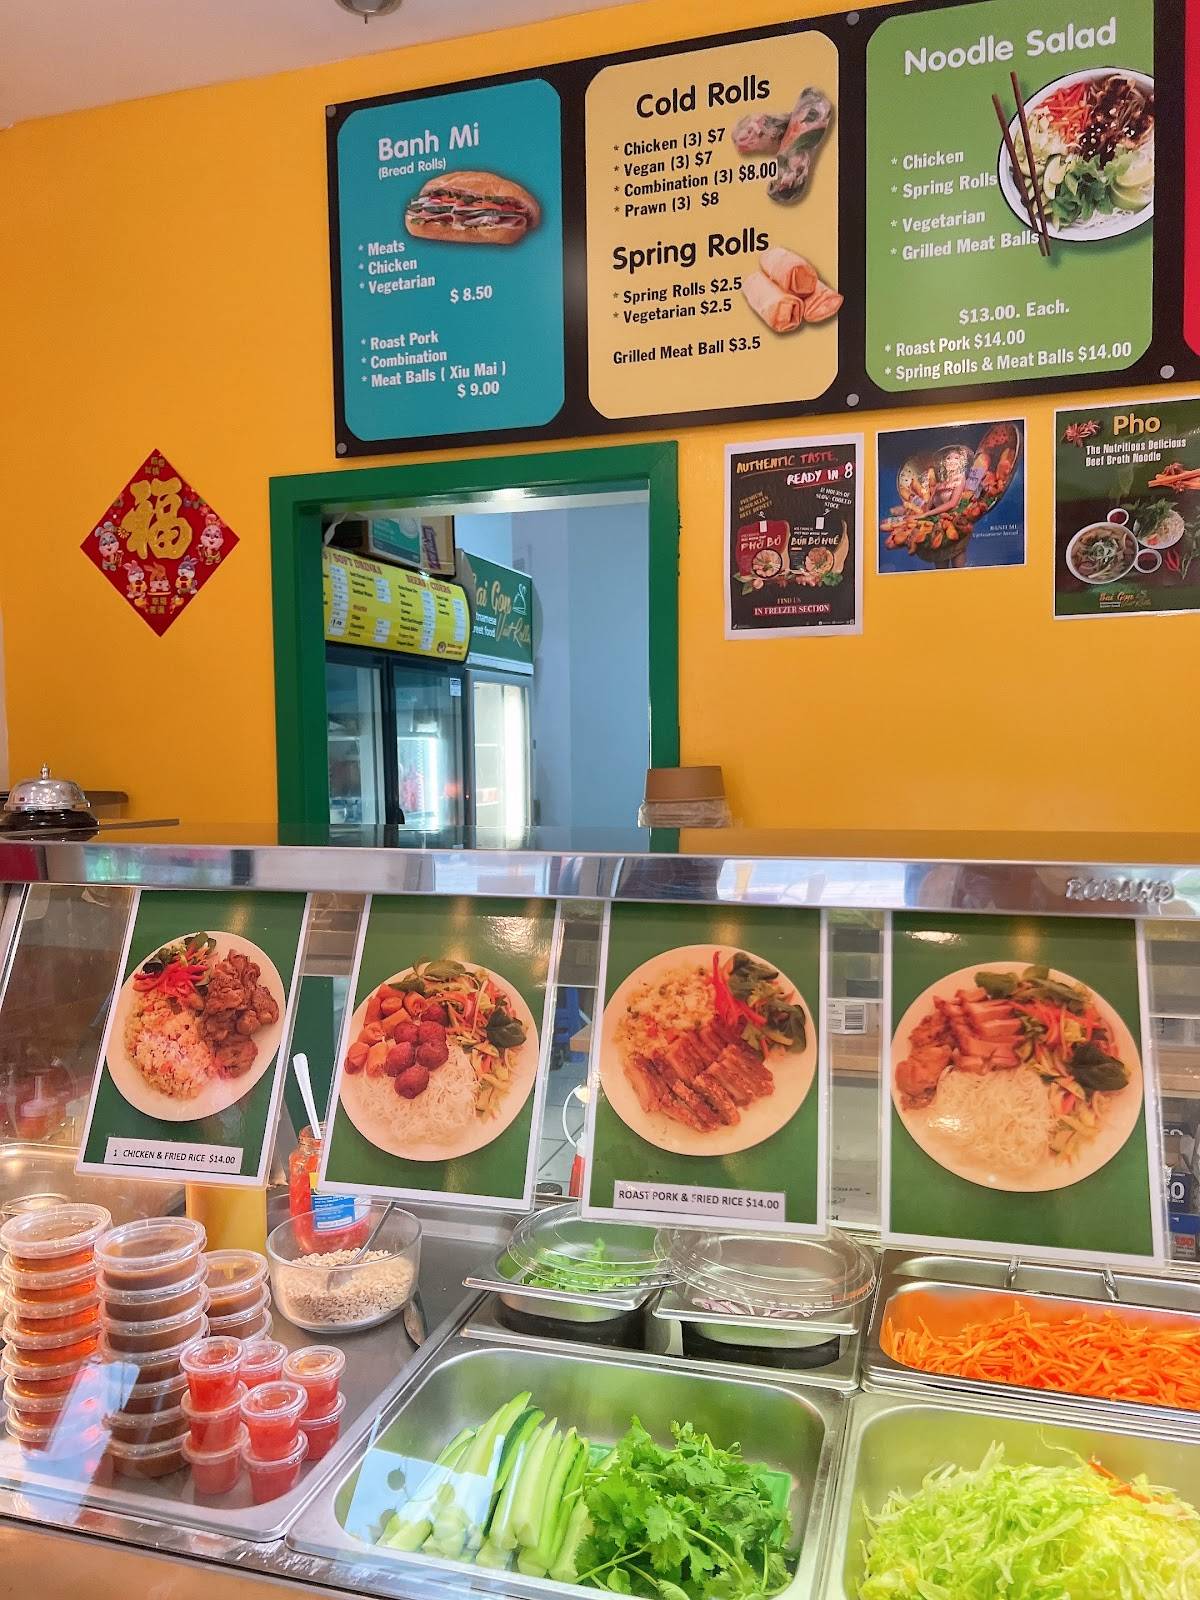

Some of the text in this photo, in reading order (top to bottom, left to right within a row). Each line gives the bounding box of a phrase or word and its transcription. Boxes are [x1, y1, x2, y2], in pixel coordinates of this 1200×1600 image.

[904, 16, 1117, 76] Noodle Salad
[636, 75, 770, 118] Cold Rolls
[378, 122, 479, 161] Banh Mi
[624, 128, 726, 156] Chicken (3) $7
[378, 158, 446, 180] (Bread Rolls)
[624, 151, 713, 177] Vegan (3) $7
[902, 151, 964, 170] Chicken
[624, 161, 777, 197] Combination (3) $8.00
[903, 172, 998, 200] Spring Rolls
[625, 192, 720, 217] Prawn (3) $8
[902, 210, 986, 233] Vegetarian
[368, 240, 405, 256] Meats
[612, 227, 769, 274] Spring Rolls
[902, 230, 1040, 261] Grilled Meat Balls
[368, 259, 418, 275] Chicken
[368, 275, 436, 294] Vegetarian
[623, 276, 742, 305] Spring Rolls $2.5
[624, 298, 732, 324] Vegetarian $2.5
[959, 299, 1070, 325] $13.00. Each.
[370, 330, 439, 350] Roast Pork
[613, 336, 761, 365] Grilled Meat Ball $3.5
[896, 329, 1026, 357] Roast Pork $14.00
[370, 350, 447, 369] Combination
[895, 341, 1132, 382] Spring Rolls & Meat Balls $14.00
[371, 372, 401, 387] Meat
[405, 369, 436, 384] Balls
[1112, 413, 1161, 436] Pho
[1086, 439, 1186, 455] The Nutritious Delicious
[736, 455, 795, 474] AUTHENTIC
[1085, 451, 1161, 467] Beef Broth Noodle
[786, 462, 853, 485] READY IN 8
[120, 477, 193, 560] 福
[475, 612, 497, 626] tnamese
[754, 604, 829, 616] IN FREEZER SECTION
[484, 626, 496, 638] food
[113, 1149, 236, 1164] 1 CHICKEN & FRIED RICE $14.00
[619, 1190, 779, 1210] ROAST PORK & FRIED RICE $14.00
